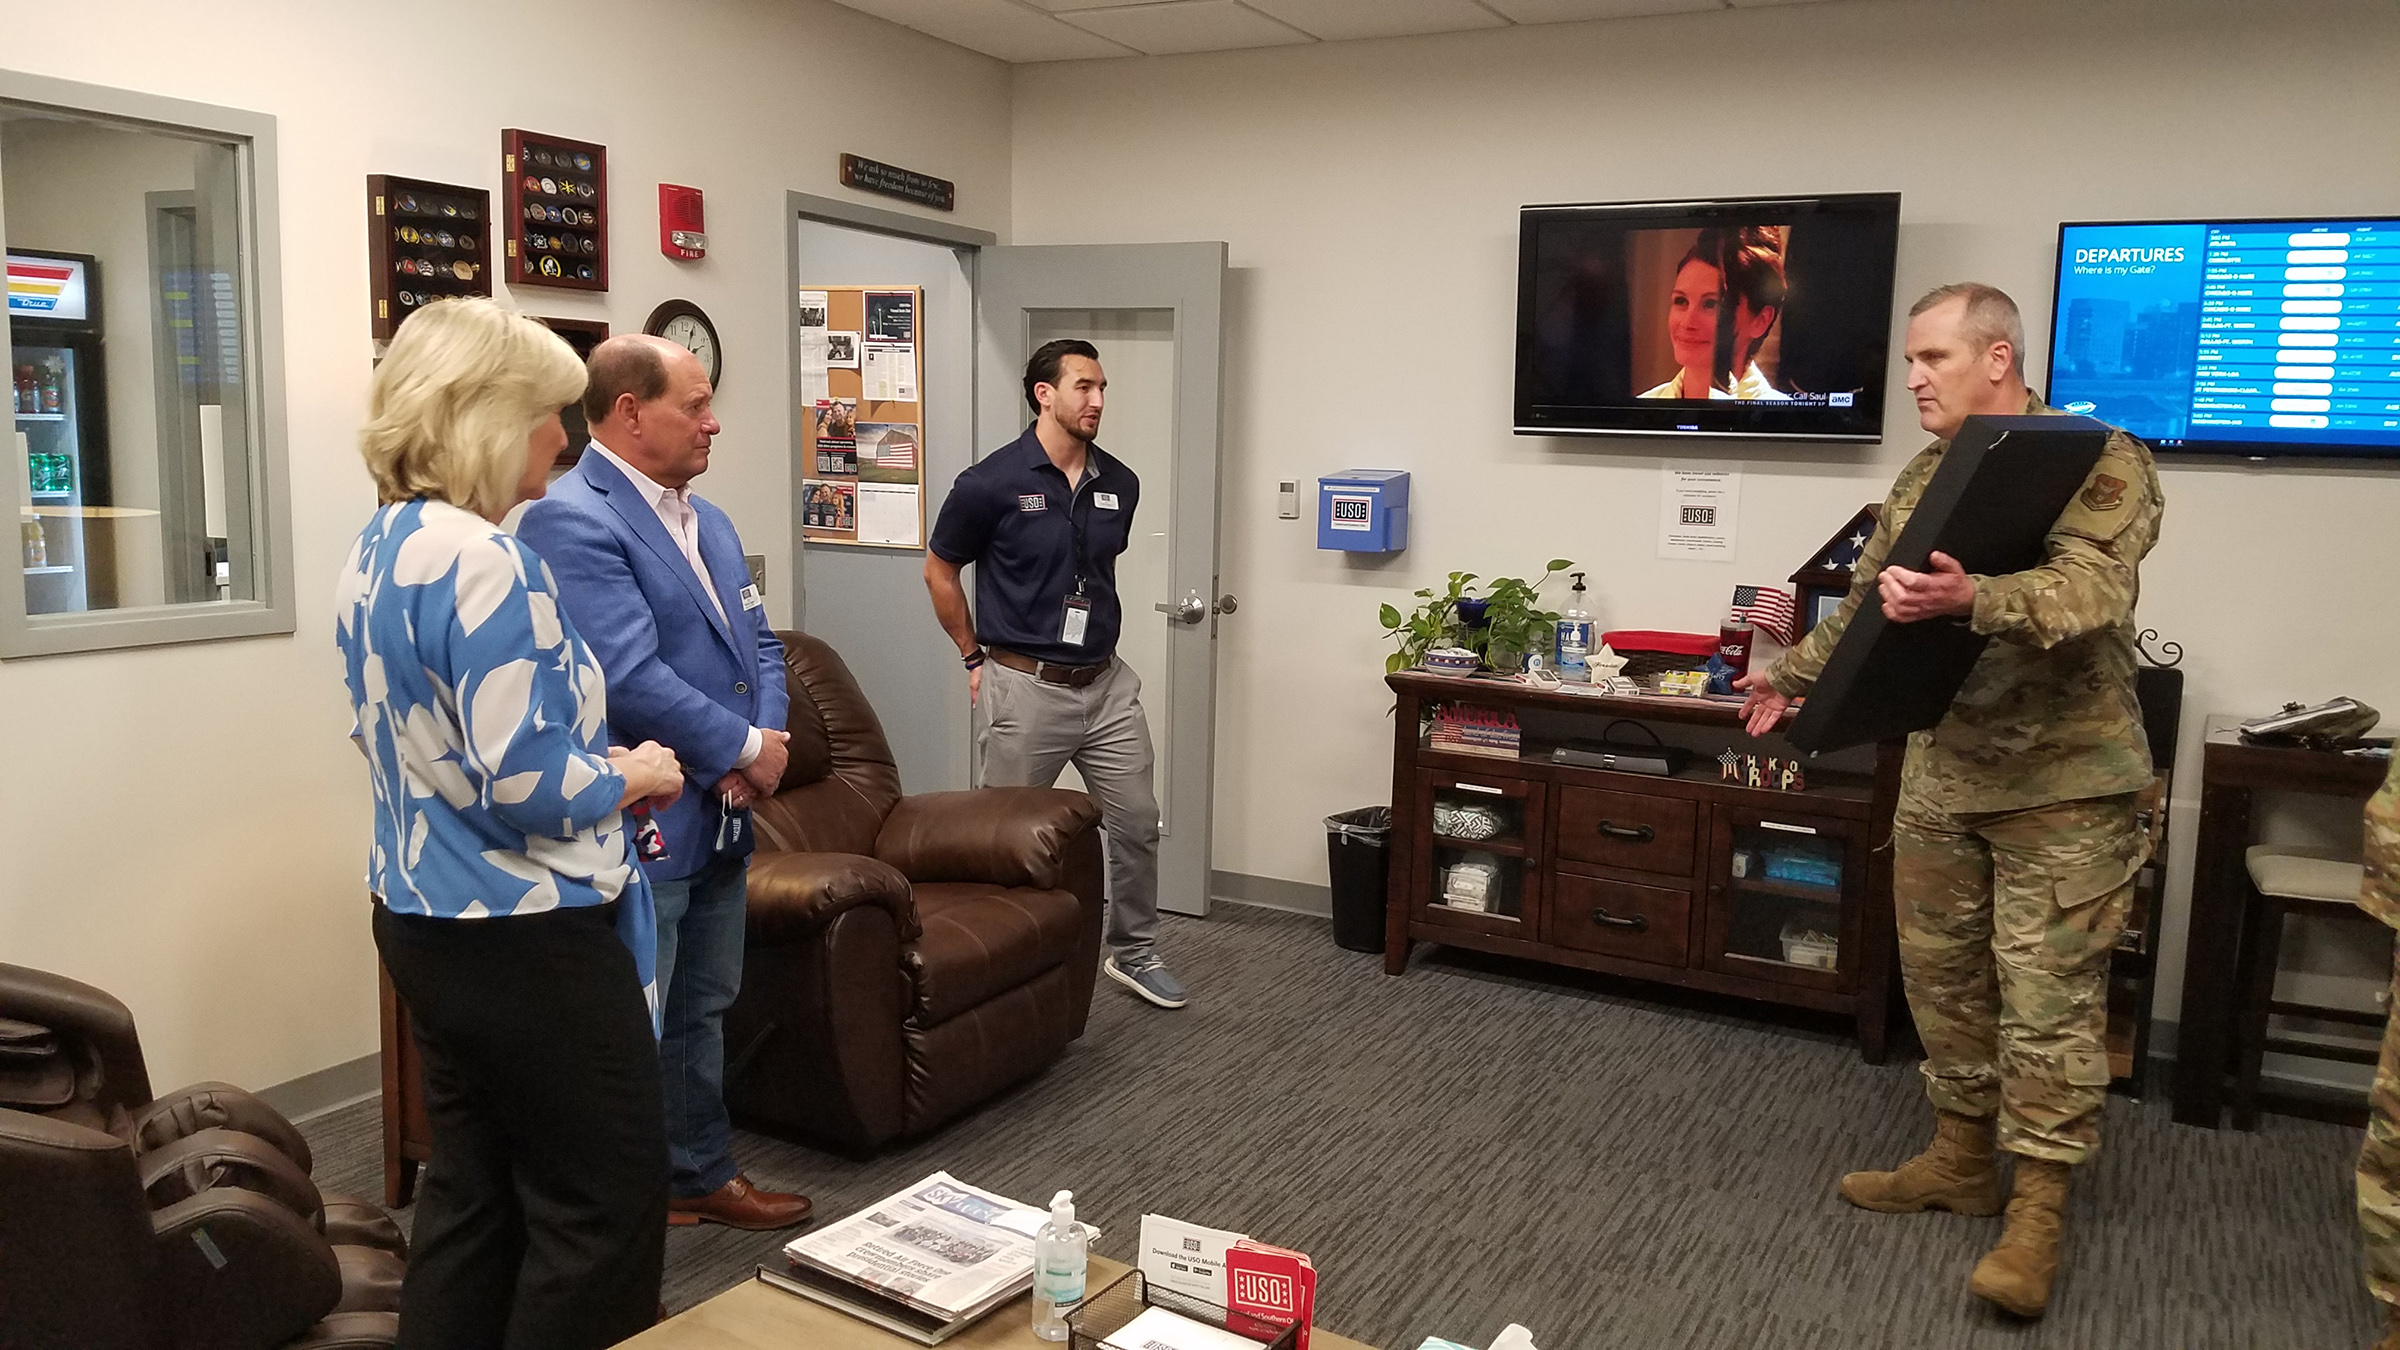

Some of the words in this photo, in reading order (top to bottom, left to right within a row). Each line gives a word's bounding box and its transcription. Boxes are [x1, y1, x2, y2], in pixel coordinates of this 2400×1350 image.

[878, 179, 904, 192] freedom
[681, 250, 699, 258] FIRE
[2075, 247, 2184, 263] DEPARTURES
[2074, 266, 2103, 274] Where
[2105, 266, 2112, 274] is
[2114, 267, 2128, 276] my
[2129, 265, 2156, 274] Gate?
[670, 325, 677, 336] 11
[681, 321, 689, 333] 12
[1793, 392, 1808, 400] Call
[1809, 392, 1826, 400] Saul
[1025, 497, 1039, 509] USO
[1341, 502, 1361, 518] USO
[1687, 509, 1708, 522] USO
[1435, 703, 1519, 729] AMERICA
[1741, 765, 1805, 791] TROOPS
[855, 1246, 916, 1270] crewmembers
[915, 1269, 942, 1279] share
[862, 1241, 896, 1257] Retired
[907, 1260, 934, 1270] Force
[933, 1267, 951, 1275] One
[1152, 1247, 1177, 1259] Download
[1188, 1256, 1200, 1264] USO
[1202, 1259, 1221, 1268] Mobile
[846, 1251, 901, 1273] presidential
[898, 1269, 931, 1282] stories
[1245, 1274, 1281, 1305] USO
[1261, 1313, 1286, 1323] Southern
